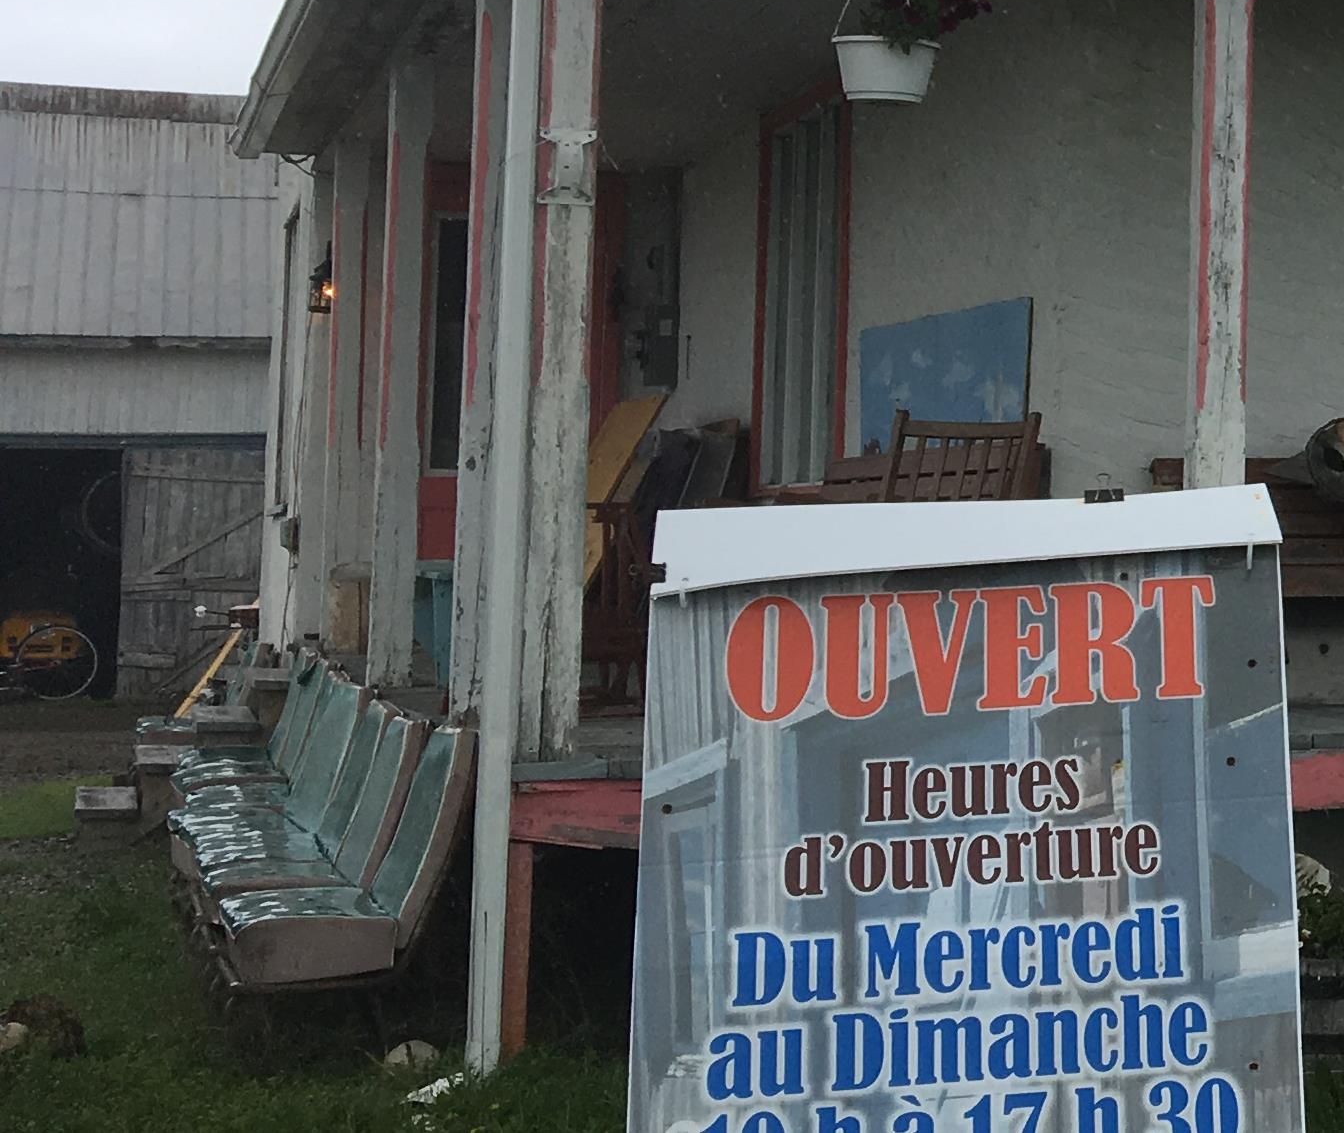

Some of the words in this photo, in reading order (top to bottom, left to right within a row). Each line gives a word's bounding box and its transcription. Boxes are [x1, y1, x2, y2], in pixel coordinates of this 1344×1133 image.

[725, 574, 1215, 722] OUVERT
[864, 757, 1080, 822] Heures
[732, 930, 837, 1007] Du
[864, 904, 1185, 999] Mercredi
[706, 1028, 805, 1100] au
[831, 994, 1208, 1091] Dimanche
[1148, 1077, 1240, 1133] 30
